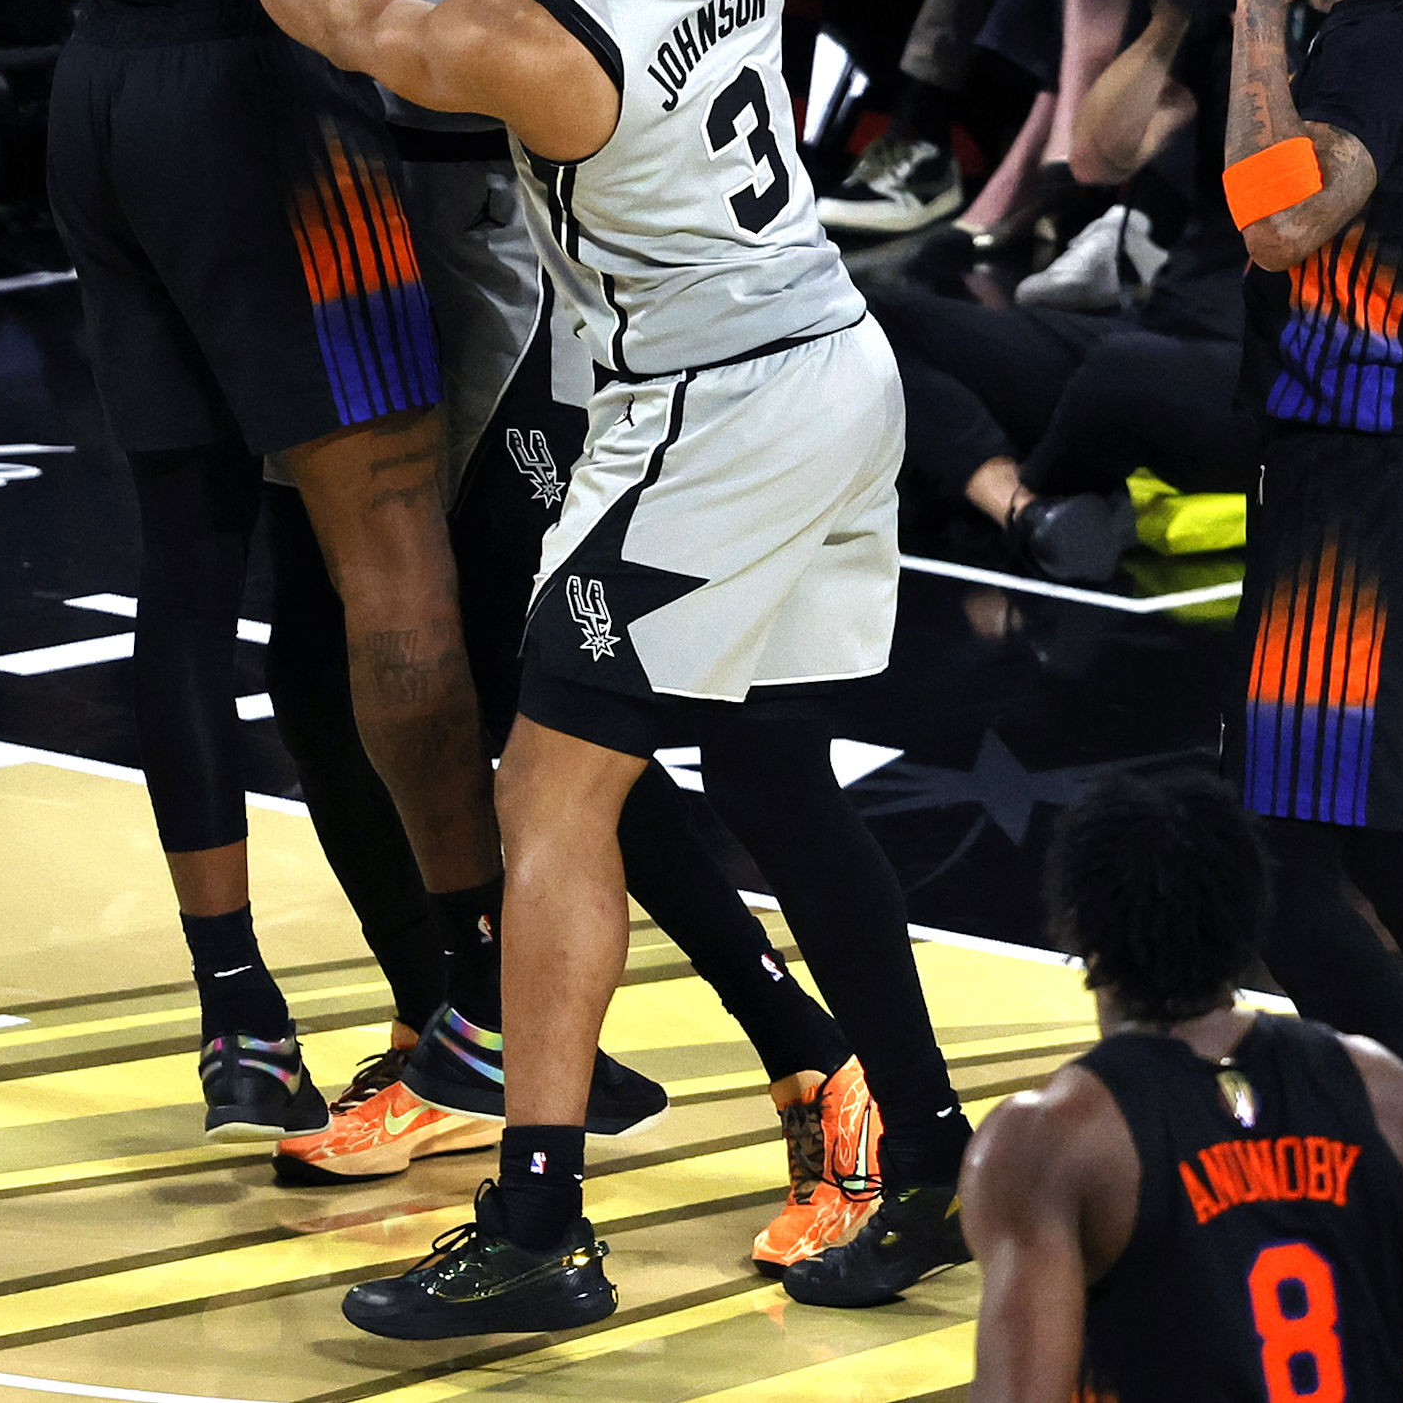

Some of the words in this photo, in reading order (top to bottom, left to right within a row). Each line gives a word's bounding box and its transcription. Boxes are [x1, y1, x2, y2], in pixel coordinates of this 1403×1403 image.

[703, 63, 792, 237] 3
[1178, 1135, 1363, 1225] ANUNOBY
[1248, 1242, 1347, 1403] 8
